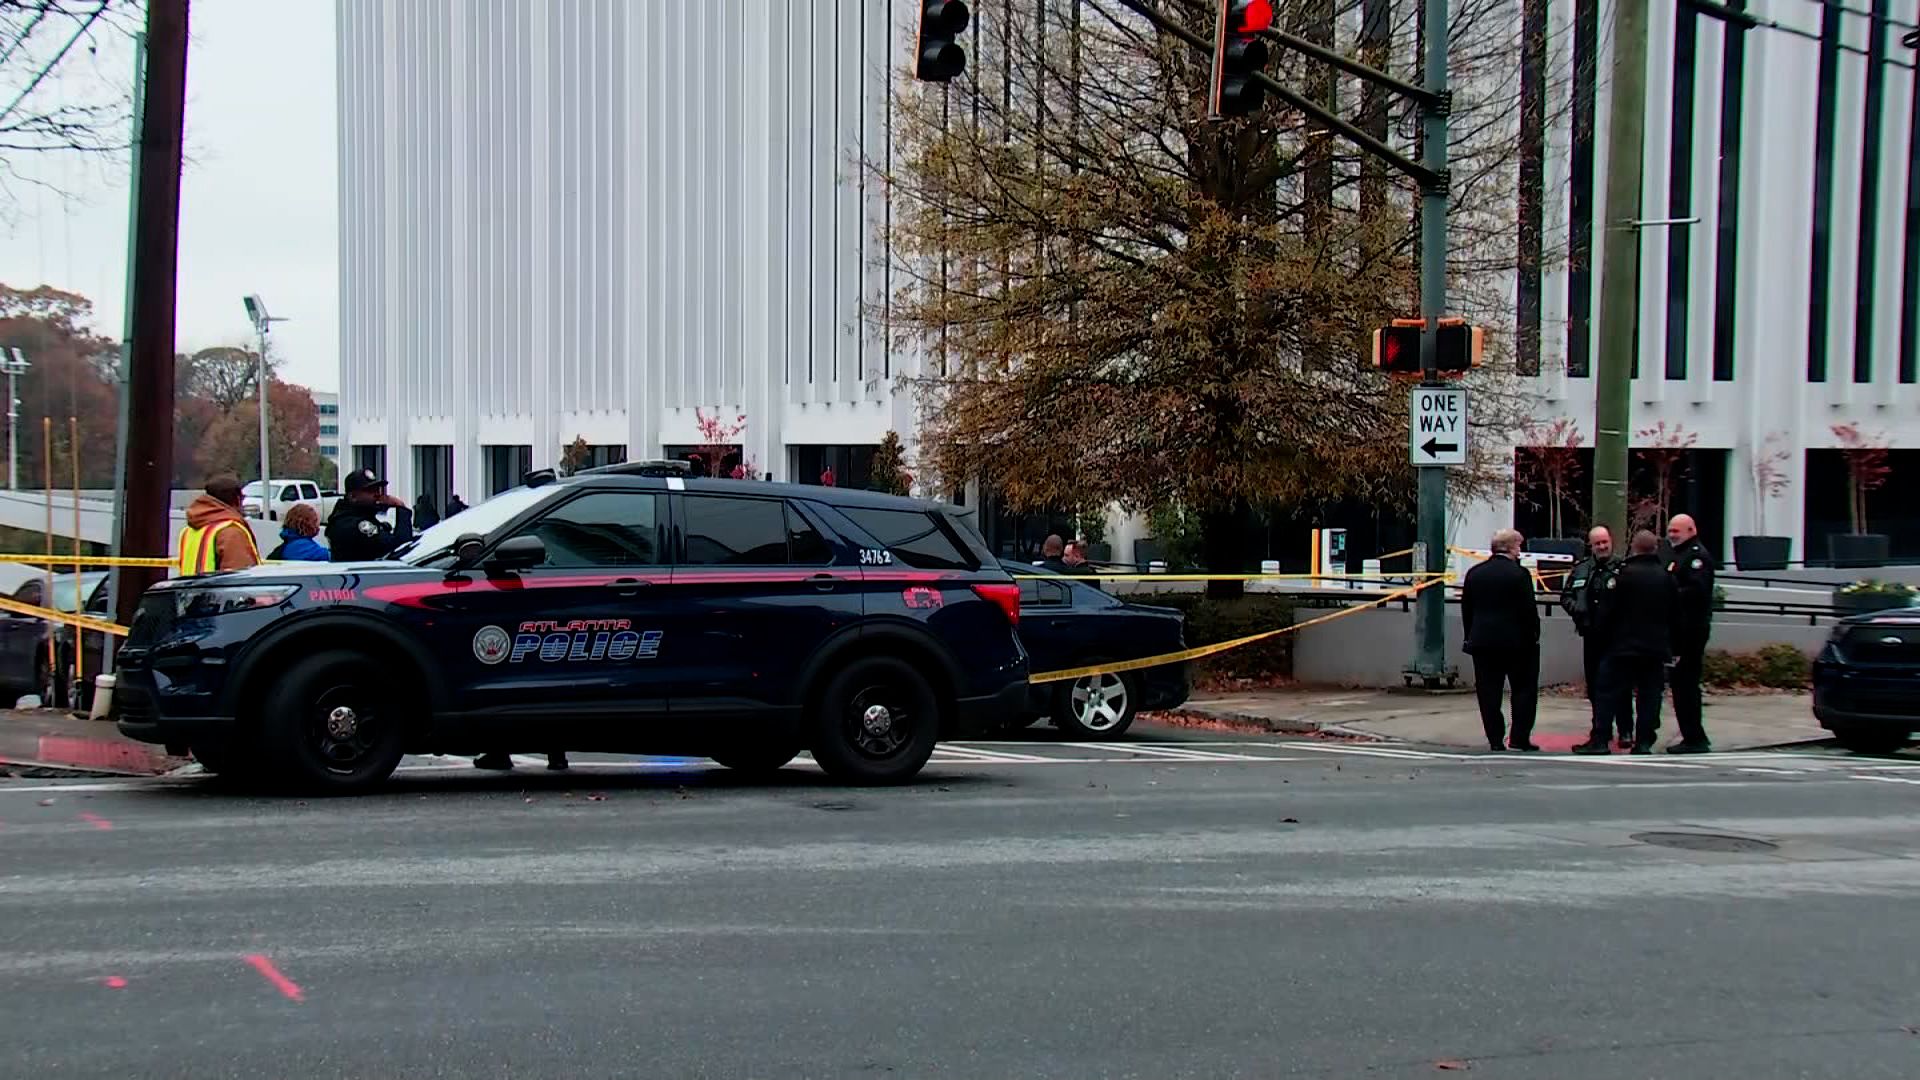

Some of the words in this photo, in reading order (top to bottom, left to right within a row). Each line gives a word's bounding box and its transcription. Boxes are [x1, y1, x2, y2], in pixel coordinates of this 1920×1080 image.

[1421, 394, 1457, 412] ONE
[1420, 415, 1458, 432] WAY
[859, 549, 892, 564] 34762
[518, 619, 632, 633] ATLANTA
[509, 630, 664, 663] POLICE
